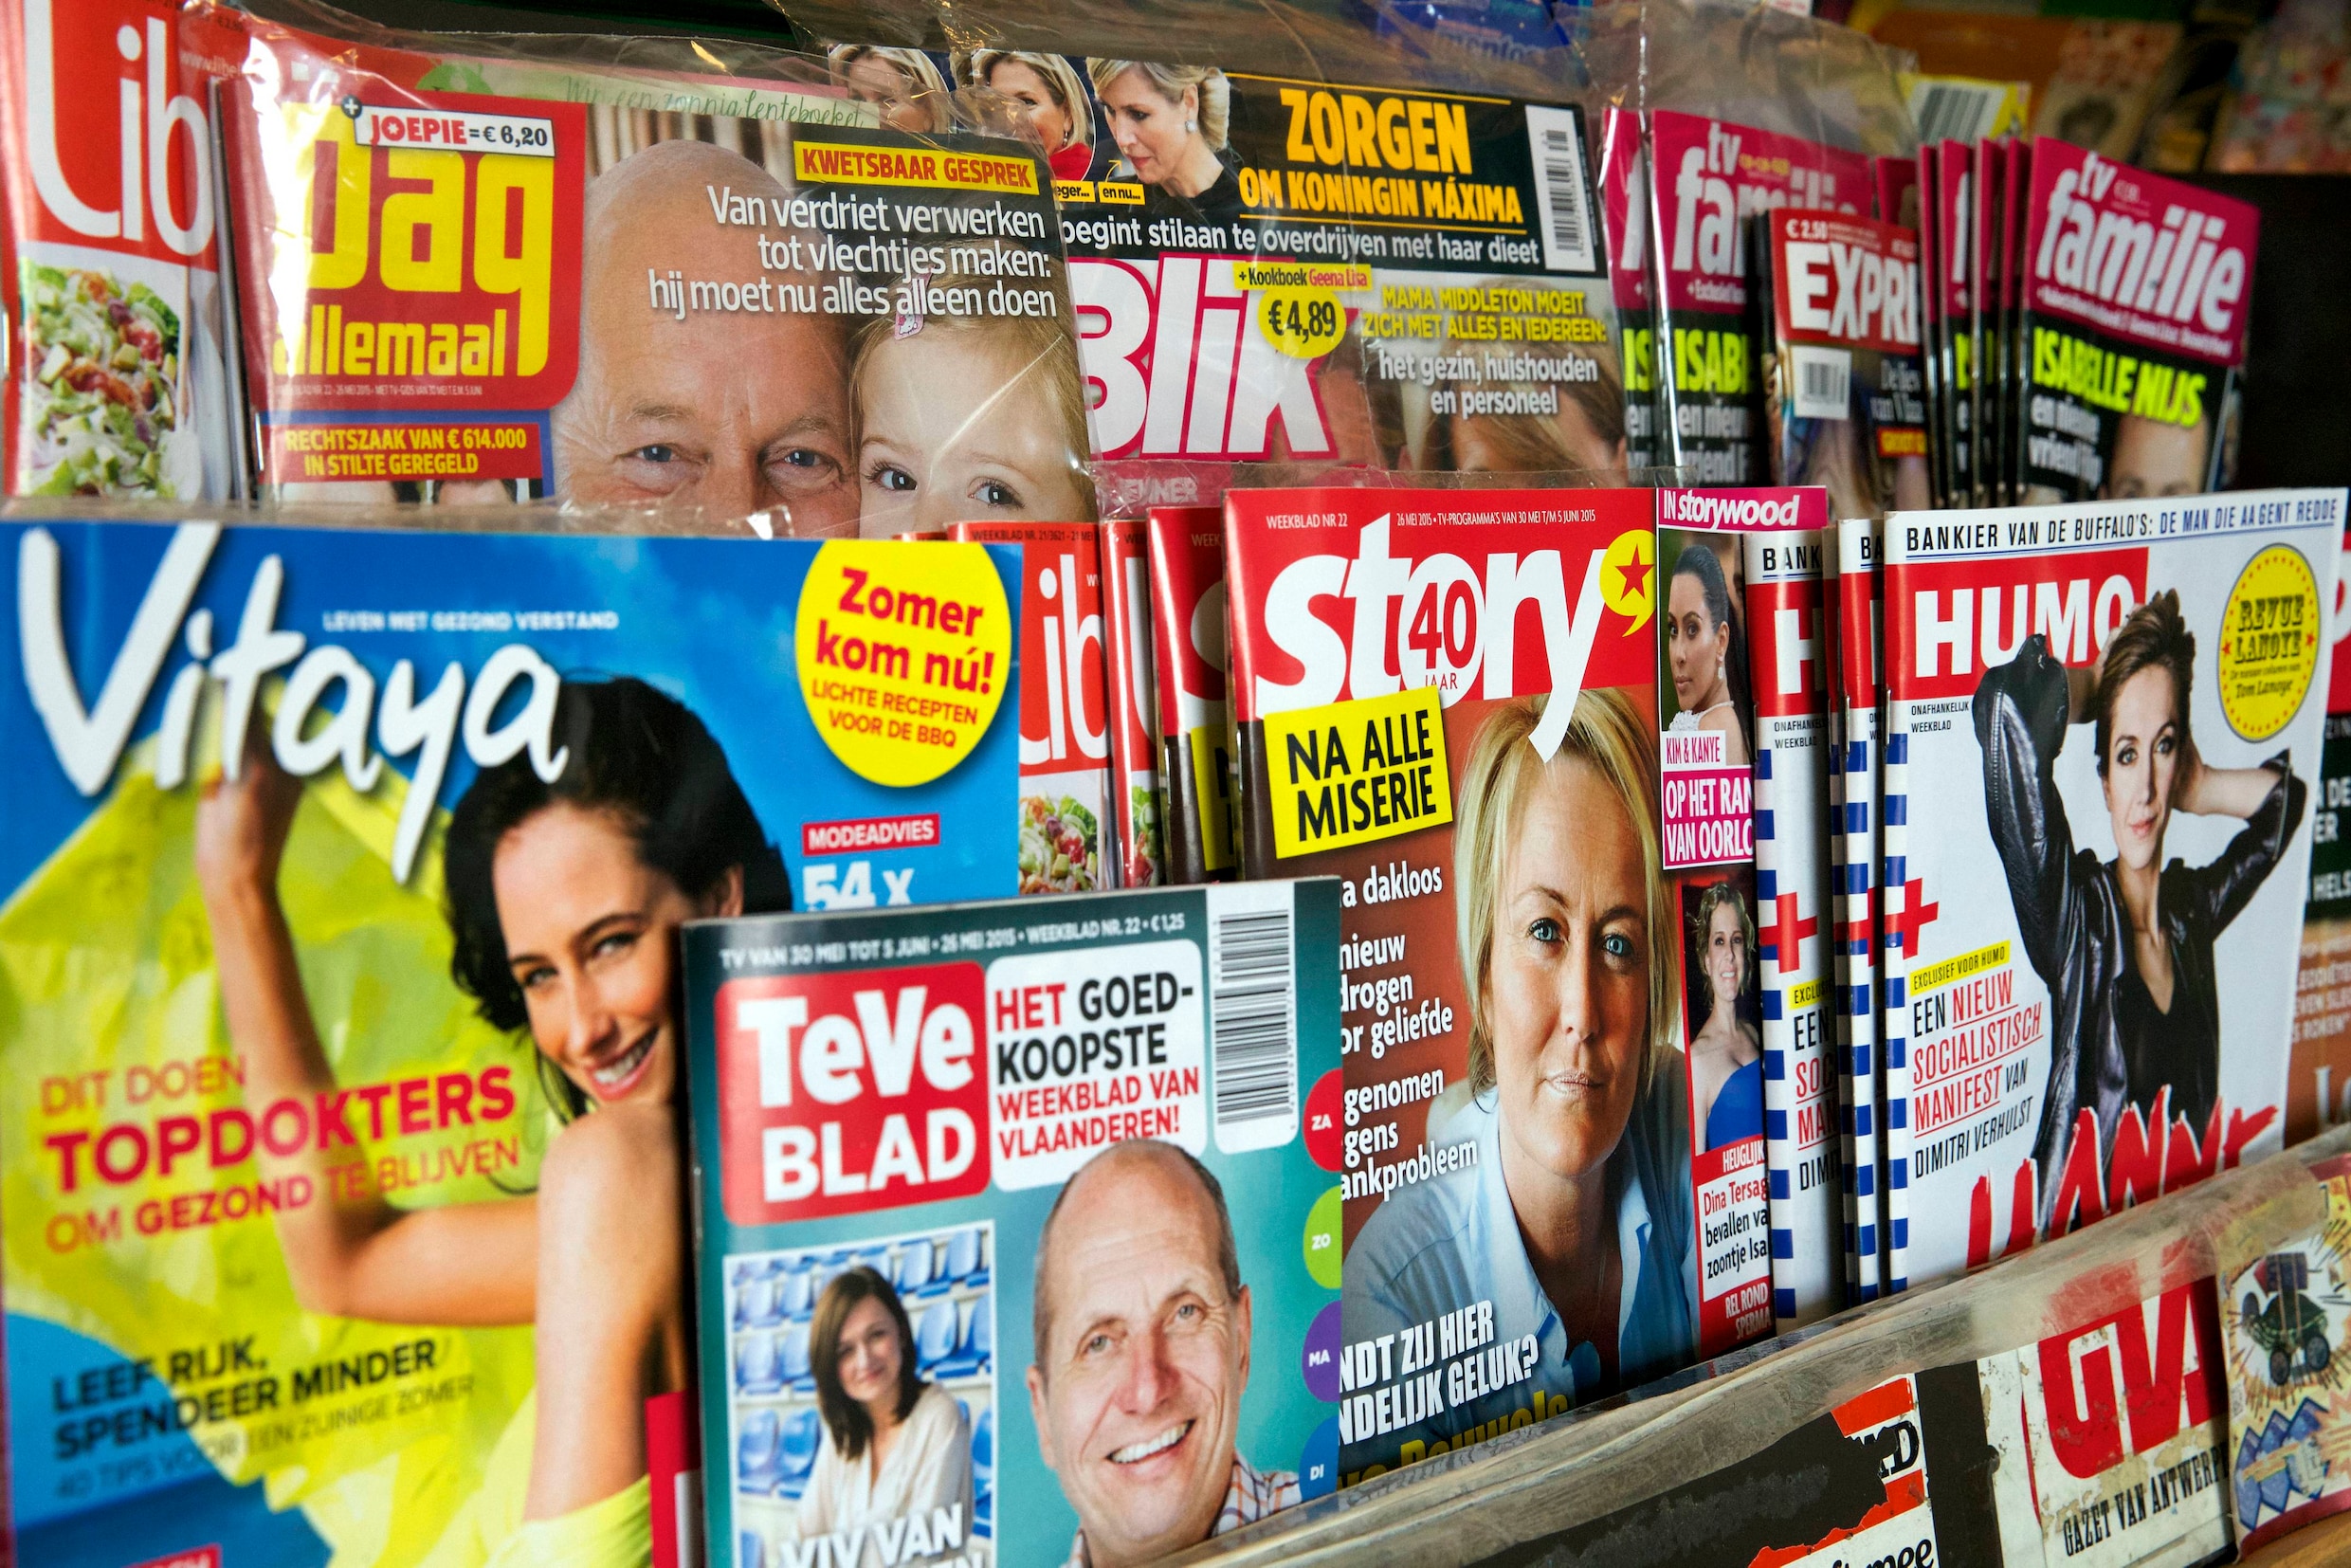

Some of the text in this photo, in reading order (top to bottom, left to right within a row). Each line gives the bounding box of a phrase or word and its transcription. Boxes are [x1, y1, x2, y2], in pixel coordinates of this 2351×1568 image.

[1280, 88, 1472, 175] ZORGEN
[803, 149, 1031, 188] KWETSBAAR GESPREK
[1239, 166, 1284, 208] OM
[1287, 170, 1420, 219] KONINGIN
[1423, 173, 1523, 224] MÁXIMA
[2077, 150, 2118, 202] tv
[706, 185, 1046, 239] Van verdriet verwerken
[757, 235, 1051, 283] tot vlechtjes maken:
[1148, 216, 1228, 249] stilaan
[1231, 223, 1257, 249] te
[1263, 223, 1386, 257] overdrijven
[1391, 229, 1431, 260] met
[1437, 229, 1485, 262] haar
[1488, 232, 1540, 265] dieet
[2034, 168, 2246, 332] familie
[648, 268, 1058, 321] hij moet nu alles alleen doen
[1267, 299, 1337, 342] €4,89
[1382, 288, 1586, 316] MAMA MIDDLETON MOEIT
[272, 304, 507, 377] allemaal
[1362, 314, 1608, 342] ZICH MET ALLES EN IEDEREEN:
[1378, 350, 1416, 381] het
[1420, 352, 1483, 388] gezin,
[1485, 352, 1598, 382] huishouden
[2032, 326, 2207, 428] ISABELLE NIJS
[1431, 386, 1558, 420] en personeel
[285, 428, 526, 451] RECHTSZAAK VAN € 614.000
[304, 453, 479, 476] IN STILTE GEREGELD
[1266, 513, 1349, 530] WEEKBLAD NR 22
[1396, 509, 1596, 526] 26 MEI 2015 TV-PROGRAMMA'S VAN 30 MEI T/M 5 JUNI 2015
[1663, 488, 1801, 529] IN storywood
[1906, 522, 1999, 552] BANKIER
[2008, 520, 2039, 547] VAN
[2047, 520, 2068, 543] DE
[2074, 512, 2154, 540] BUFFALO'S:
[2160, 511, 2178, 536] DE
[2182, 508, 2210, 533] MAN
[2214, 507, 2236, 530] DIE
[2296, 499, 2338, 521] REDDE
[323, 611, 619, 631] LEVEN MET GEZOND VERSTAND
[839, 566, 984, 637] Zomer
[1408, 577, 1478, 670] 40
[1914, 574, 2136, 678] HUMO
[2237, 593, 2305, 633] REVUE
[815, 618, 995, 696] kom nú!
[1255, 512, 1610, 763] story
[2233, 629, 2303, 665] LANOYE
[18, 521, 569, 884] Vitaya
[812, 678, 978, 725] LICHTE RECEPTEN
[829, 708, 957, 748] VOOR DE BBQ
[1910, 700, 1970, 717] ONAFHANKELIJK
[1910, 719, 1953, 734] WEEKBLAD
[1285, 708, 1434, 785] NA ALLE
[1775, 735, 1818, 749] WEEKBLAD
[1297, 764, 1437, 844] MISERIE
[1665, 779, 1687, 820] OP
[1688, 778, 1718, 817] HET
[808, 819, 935, 851] MODEADVIES
[1913, 946, 2006, 992] EXCLUSIEF VOOR HUMO
[994, 971, 1195, 1032] HET GOED-
[1913, 970, 2014, 1039] EEN NIEUW
[736, 985, 975, 1109] TeVe
[996, 1023, 1168, 1086] KOOPSTE
[1913, 1001, 2043, 1085] SOCIALISTISCH
[42, 1053, 247, 1117] DIT DOEN
[996, 1067, 1201, 1124] WEEKBLAD VAN
[1343, 1068, 1444, 1126] genomen
[1913, 1057, 2028, 1133] MANIFEST VAN
[43, 1065, 517, 1193] TOPDOKTERS
[998, 1104, 1180, 1161] VLAANDEREN!
[1310, 1114, 1333, 1130] ZA
[1344, 1121, 1399, 1168] gens
[1914, 1096, 2033, 1179] DIMITRI VERHULST
[762, 1107, 977, 1204] BLAD
[1340, 1140, 1479, 1202] ankprobleem
[46, 1135, 519, 1255] OM GEZOND TE BLIJVEN
[1310, 1234, 1332, 1250] ZO
[1707, 1237, 1768, 1280] zoontje Isa
[1724, 1283, 1769, 1320] REL ROND
[1308, 1349, 1331, 1367] MA
[1340, 1300, 1494, 1393] NDT ZIJ HIER
[52, 1335, 268, 1413] LEEF RIJK.
[53, 1338, 437, 1461] SPENDEER MINDER
[1339, 1369, 1445, 1447] NDELIJK
[1447, 1332, 1540, 1408] GELUK?
[1309, 1464, 1325, 1481] DI
